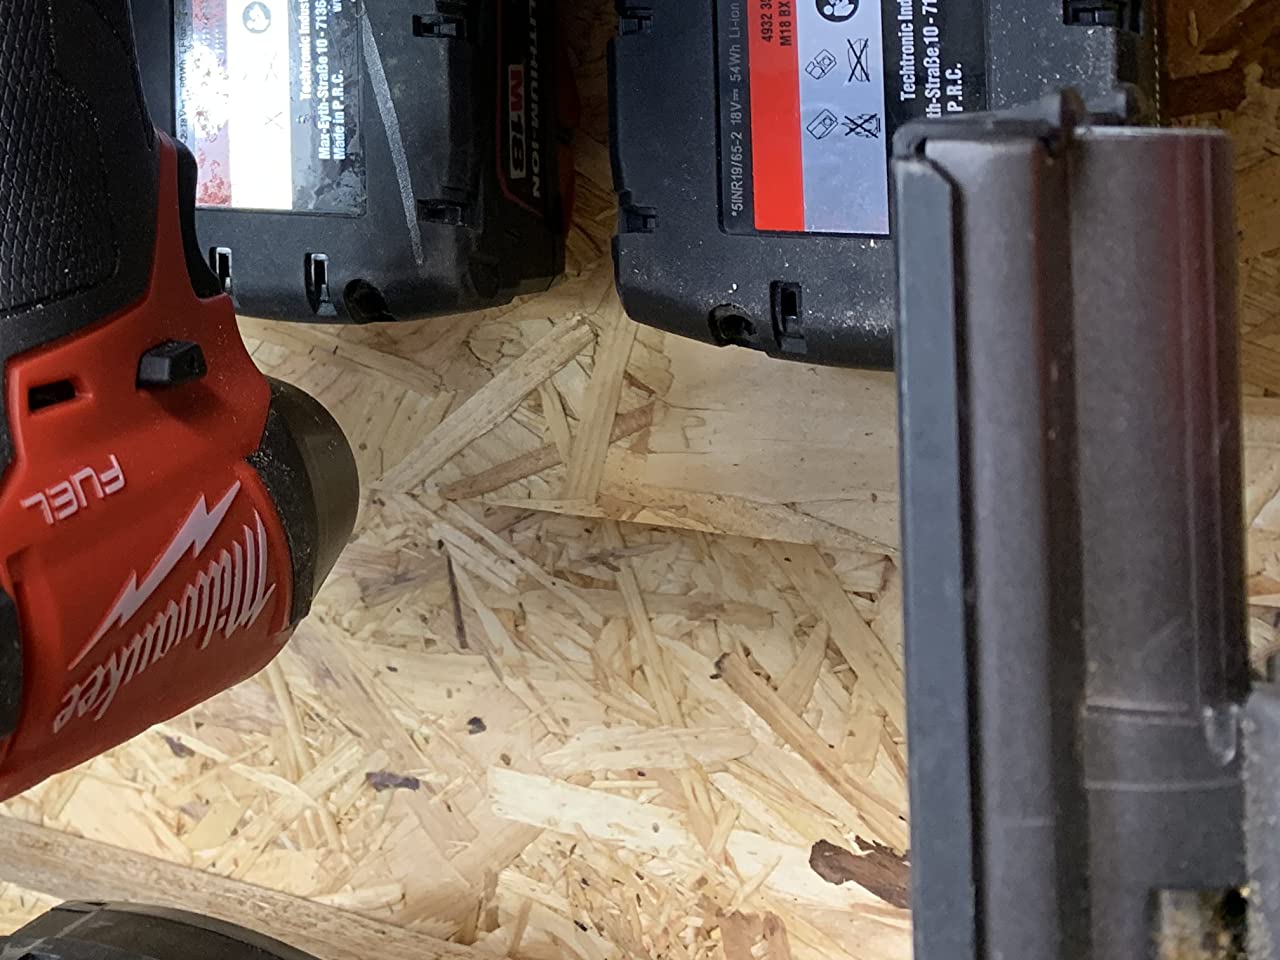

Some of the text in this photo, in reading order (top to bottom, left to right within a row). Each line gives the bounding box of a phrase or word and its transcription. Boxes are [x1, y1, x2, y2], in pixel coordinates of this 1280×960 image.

[759, 13, 774, 42] 4932
[778, 1, 791, 17] BX
[778, 20, 792, 46] M18
[923, 28, 938, 44] 10
[299, 35, 311, 100] Techtronic
[317, 40, 328, 53] 10
[729, 44, 741, 82] 54Wh
[898, 23, 915, 101] Techtronic
[317, 56, 331, 159] Max-Eyth-Straße
[331, 70, 345, 159] Made in P.R.C.
[923, 47, 941, 118] th-Straße
[946, 64, 963, 111] P.R.C.
[510, 69, 525, 173] M18
[21, 454, 126, 526] FUEL
[52, 510, 275, 734] Milwaukee
